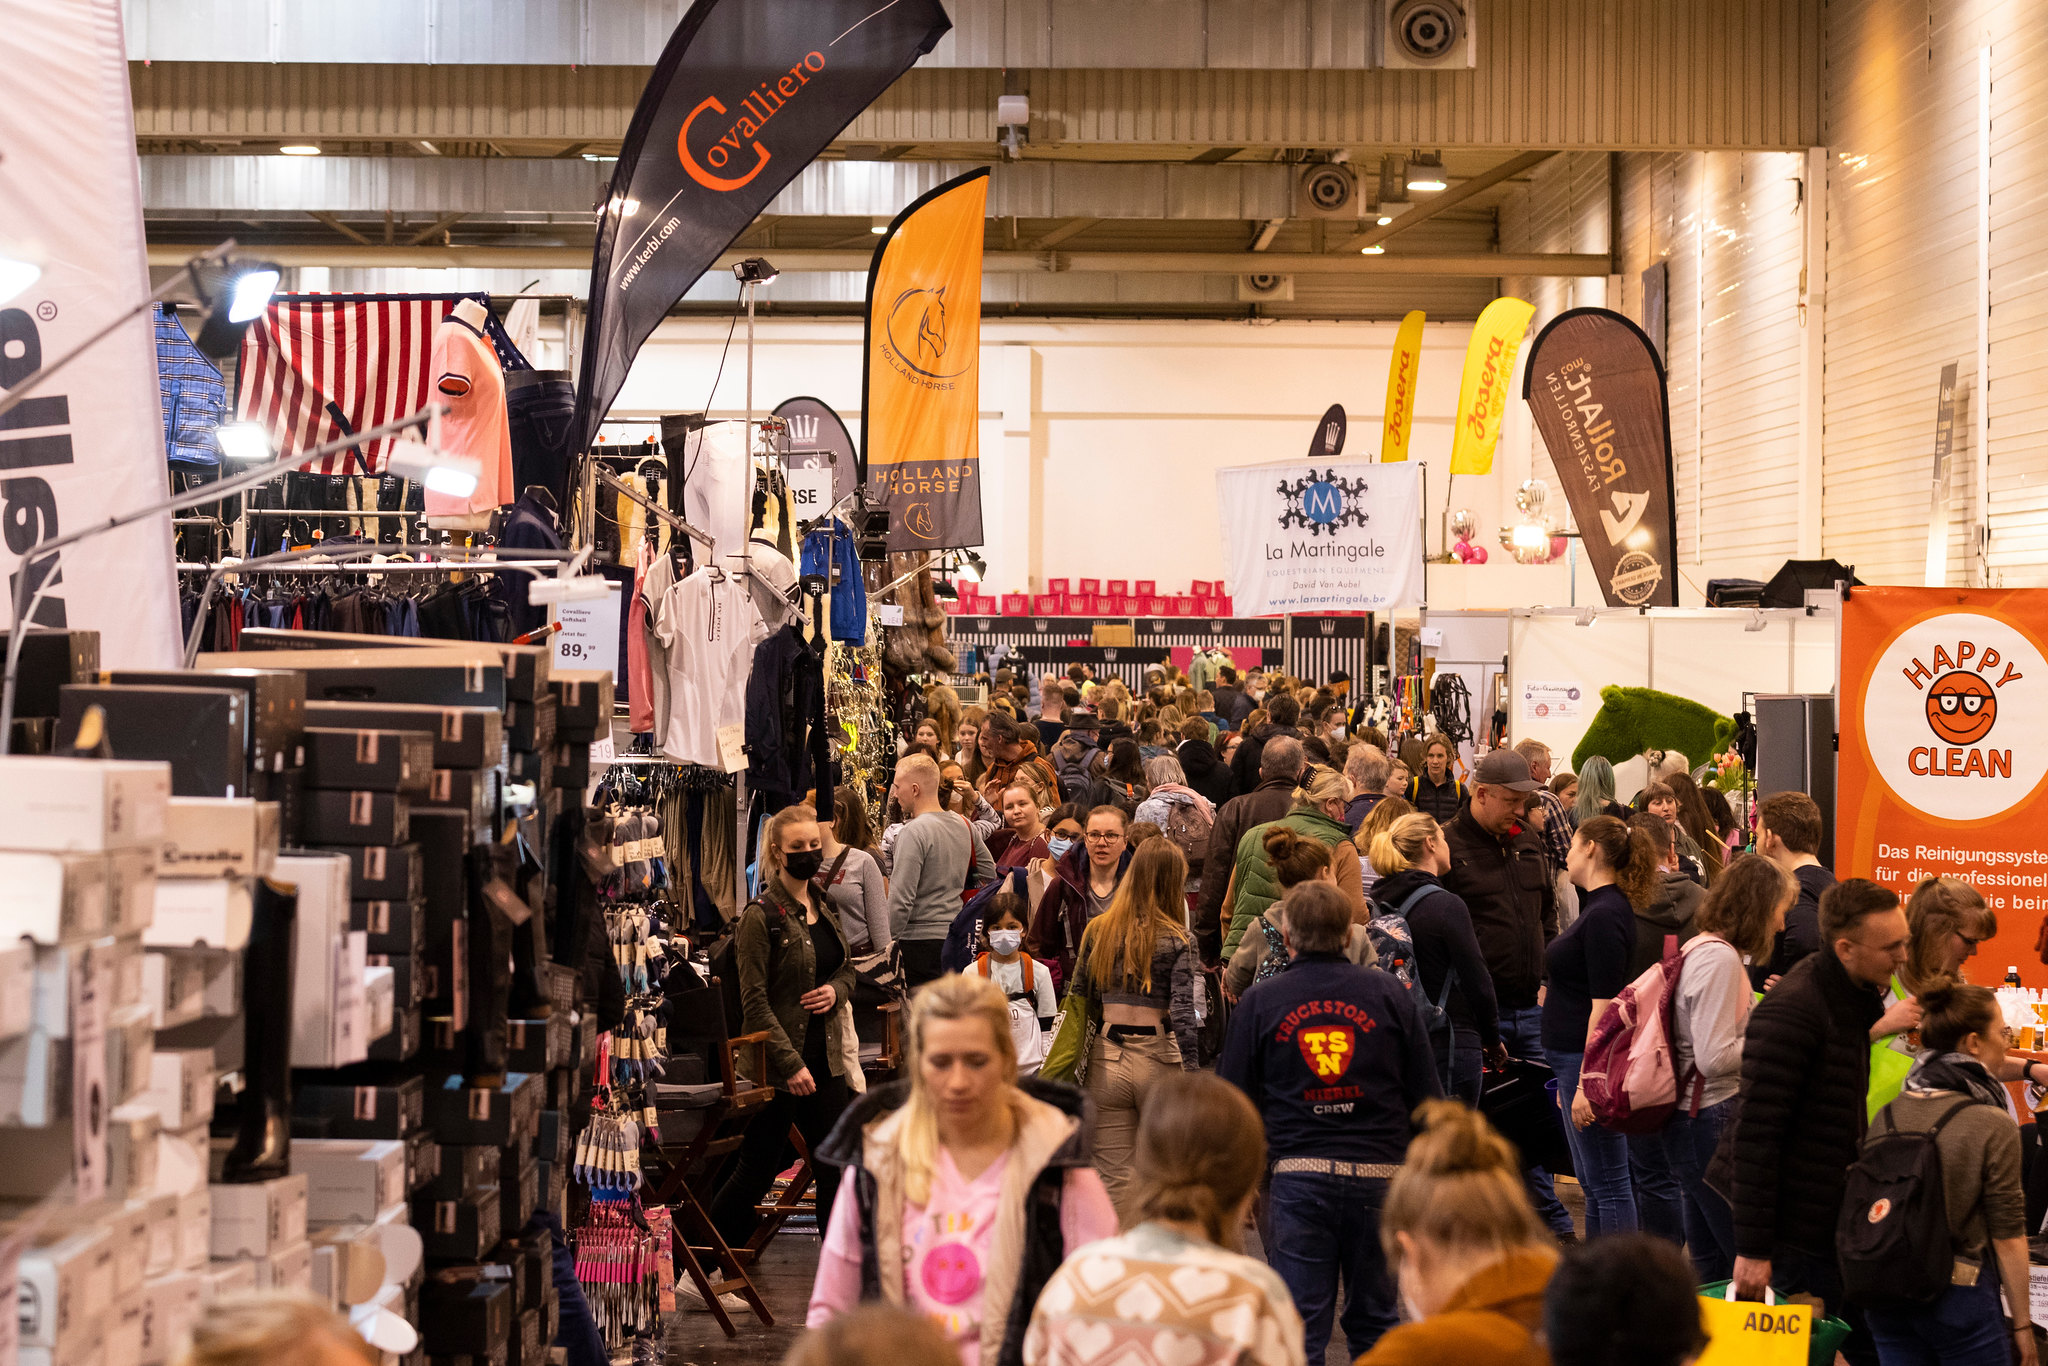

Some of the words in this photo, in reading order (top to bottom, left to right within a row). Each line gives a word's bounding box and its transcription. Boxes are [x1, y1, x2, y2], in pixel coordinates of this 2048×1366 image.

[678, 50, 826, 192] Covalliero
[620, 216, 681, 291] www.kerbl.com
[880, 343, 919, 385] HOLLAND
[921, 380, 956, 391] HORSE
[1388, 350, 1410, 447] Josera
[1467, 336, 1504, 440] Josera
[875, 465, 973, 483] HOLLAND
[889, 480, 960, 495] HORSE
[1311, 489, 1336, 514] M
[1266, 543, 1283, 560] La
[1291, 538, 1385, 562] Martingale
[1267, 567, 1326, 578] EQUESTRIAN
[1331, 567, 1385, 575] EQUIPMENT
[1293, 580, 1316, 589] David
[1320, 580, 1334, 588] Van
[1337, 579, 1361, 588] Aubel
[1269, 594, 1386, 606] www.lamartingale.be
[1902, 640, 2023, 690] HAPPY
[1908, 746, 2012, 778] CLEAN
[1878, 843, 1909, 860] Das
[1875, 866, 1900, 882] für
[1907, 868, 1933, 882] die
[1275, 1000, 1377, 1042] TRUCKSTORE
[1313, 1102, 1354, 1115] CREW
[1743, 1312, 1801, 1335] ADAC
